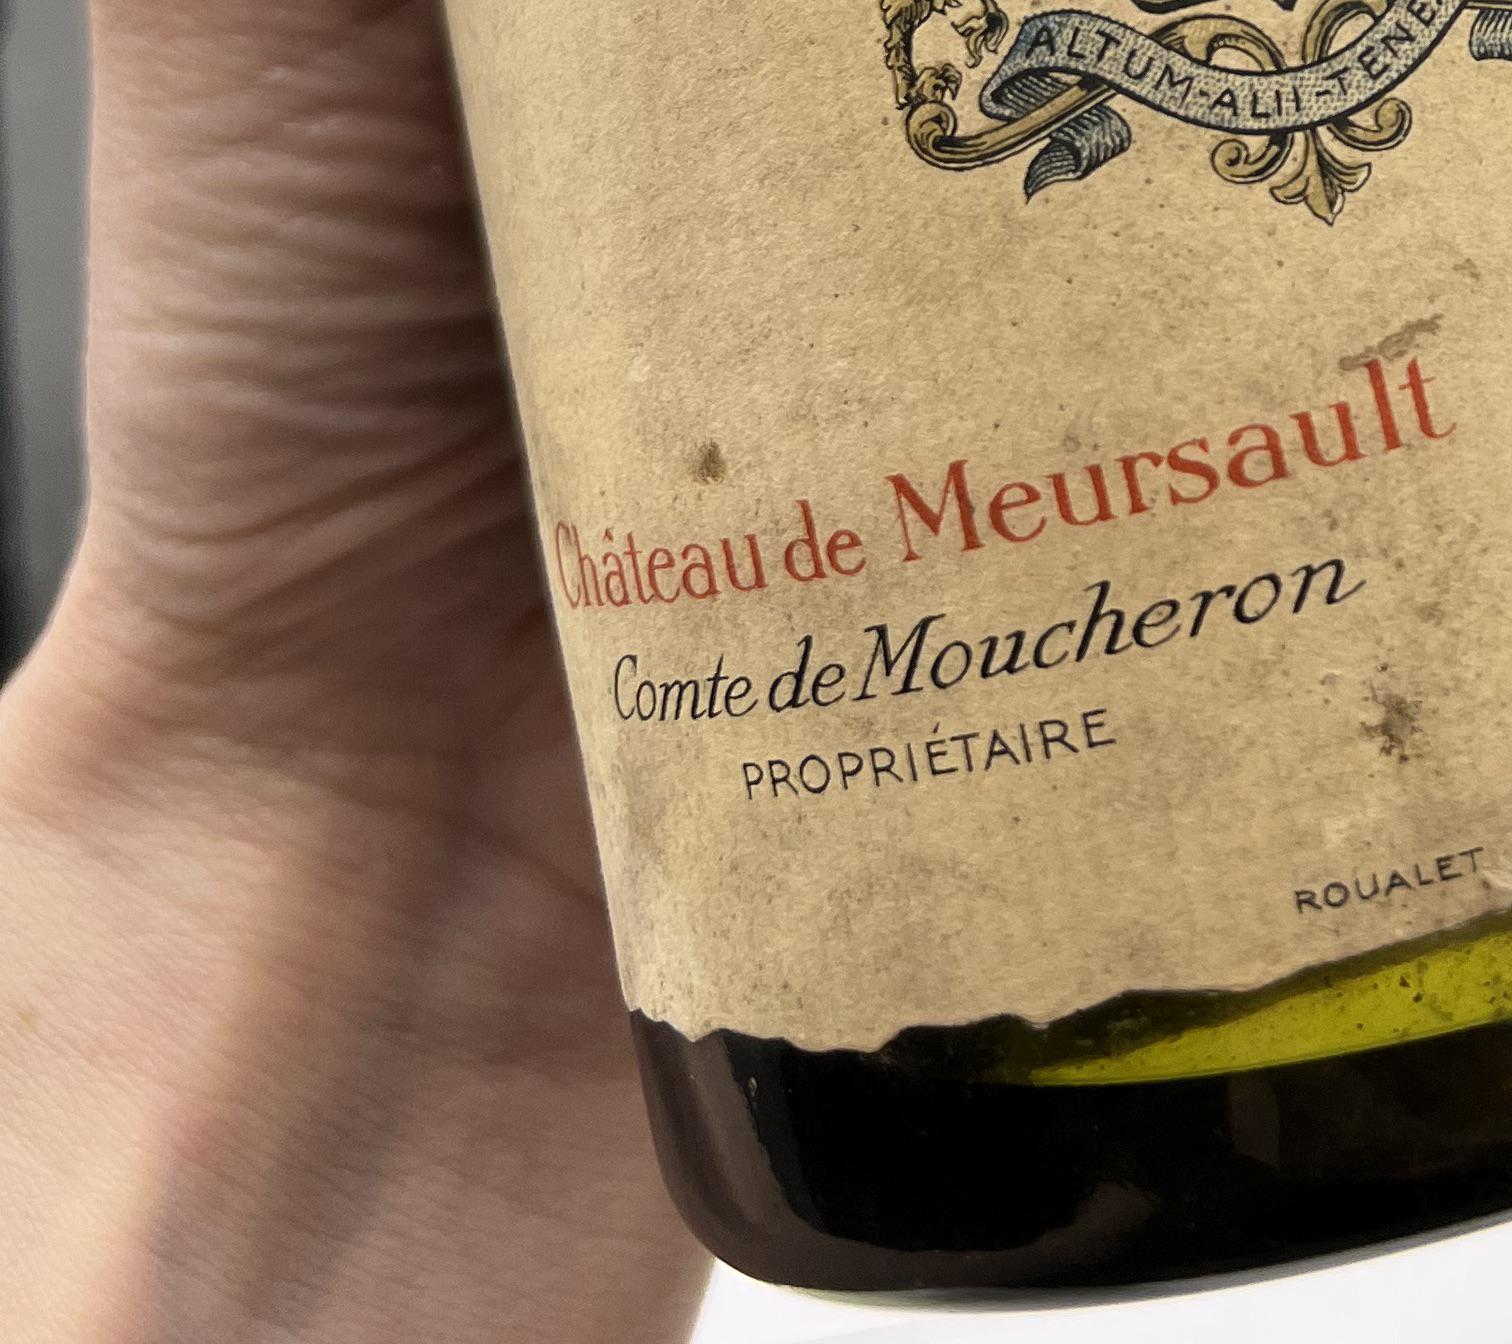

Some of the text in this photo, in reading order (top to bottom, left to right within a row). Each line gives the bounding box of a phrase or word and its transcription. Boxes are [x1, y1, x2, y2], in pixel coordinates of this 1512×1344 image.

[556, 356, 1457, 609] Château de Meursault
[614, 557, 1366, 722] Comte de Moucheron
[742, 708, 1117, 800] PROPRIÉTAIRE
[1294, 846, 1484, 913] ROUALET
